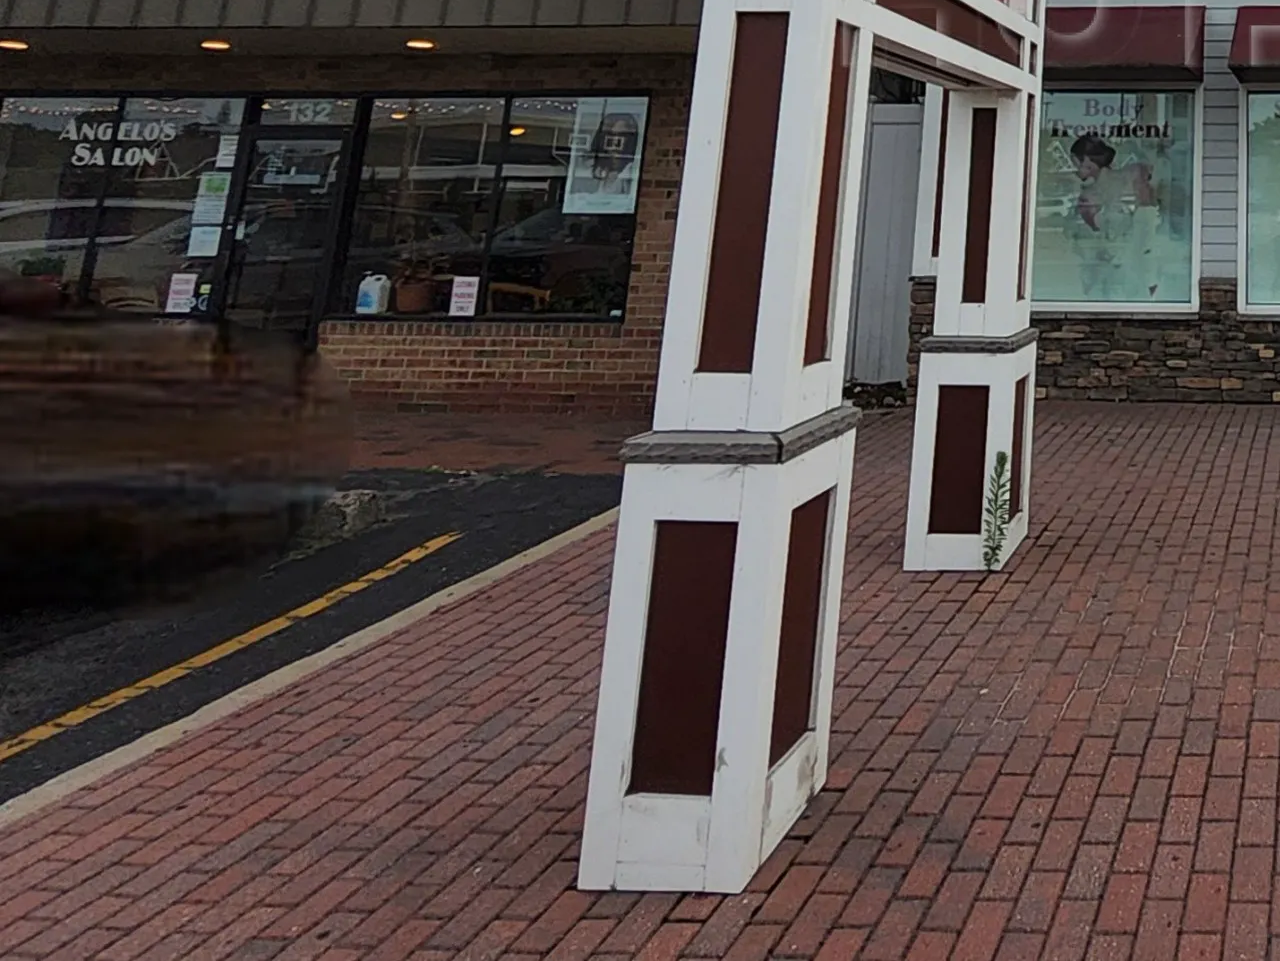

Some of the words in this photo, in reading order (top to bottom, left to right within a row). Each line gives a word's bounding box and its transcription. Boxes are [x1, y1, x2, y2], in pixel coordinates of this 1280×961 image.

[288, 102, 333, 124] 132
[1083, 97, 1146, 125] Body
[1047, 118, 1172, 140] Treatment
